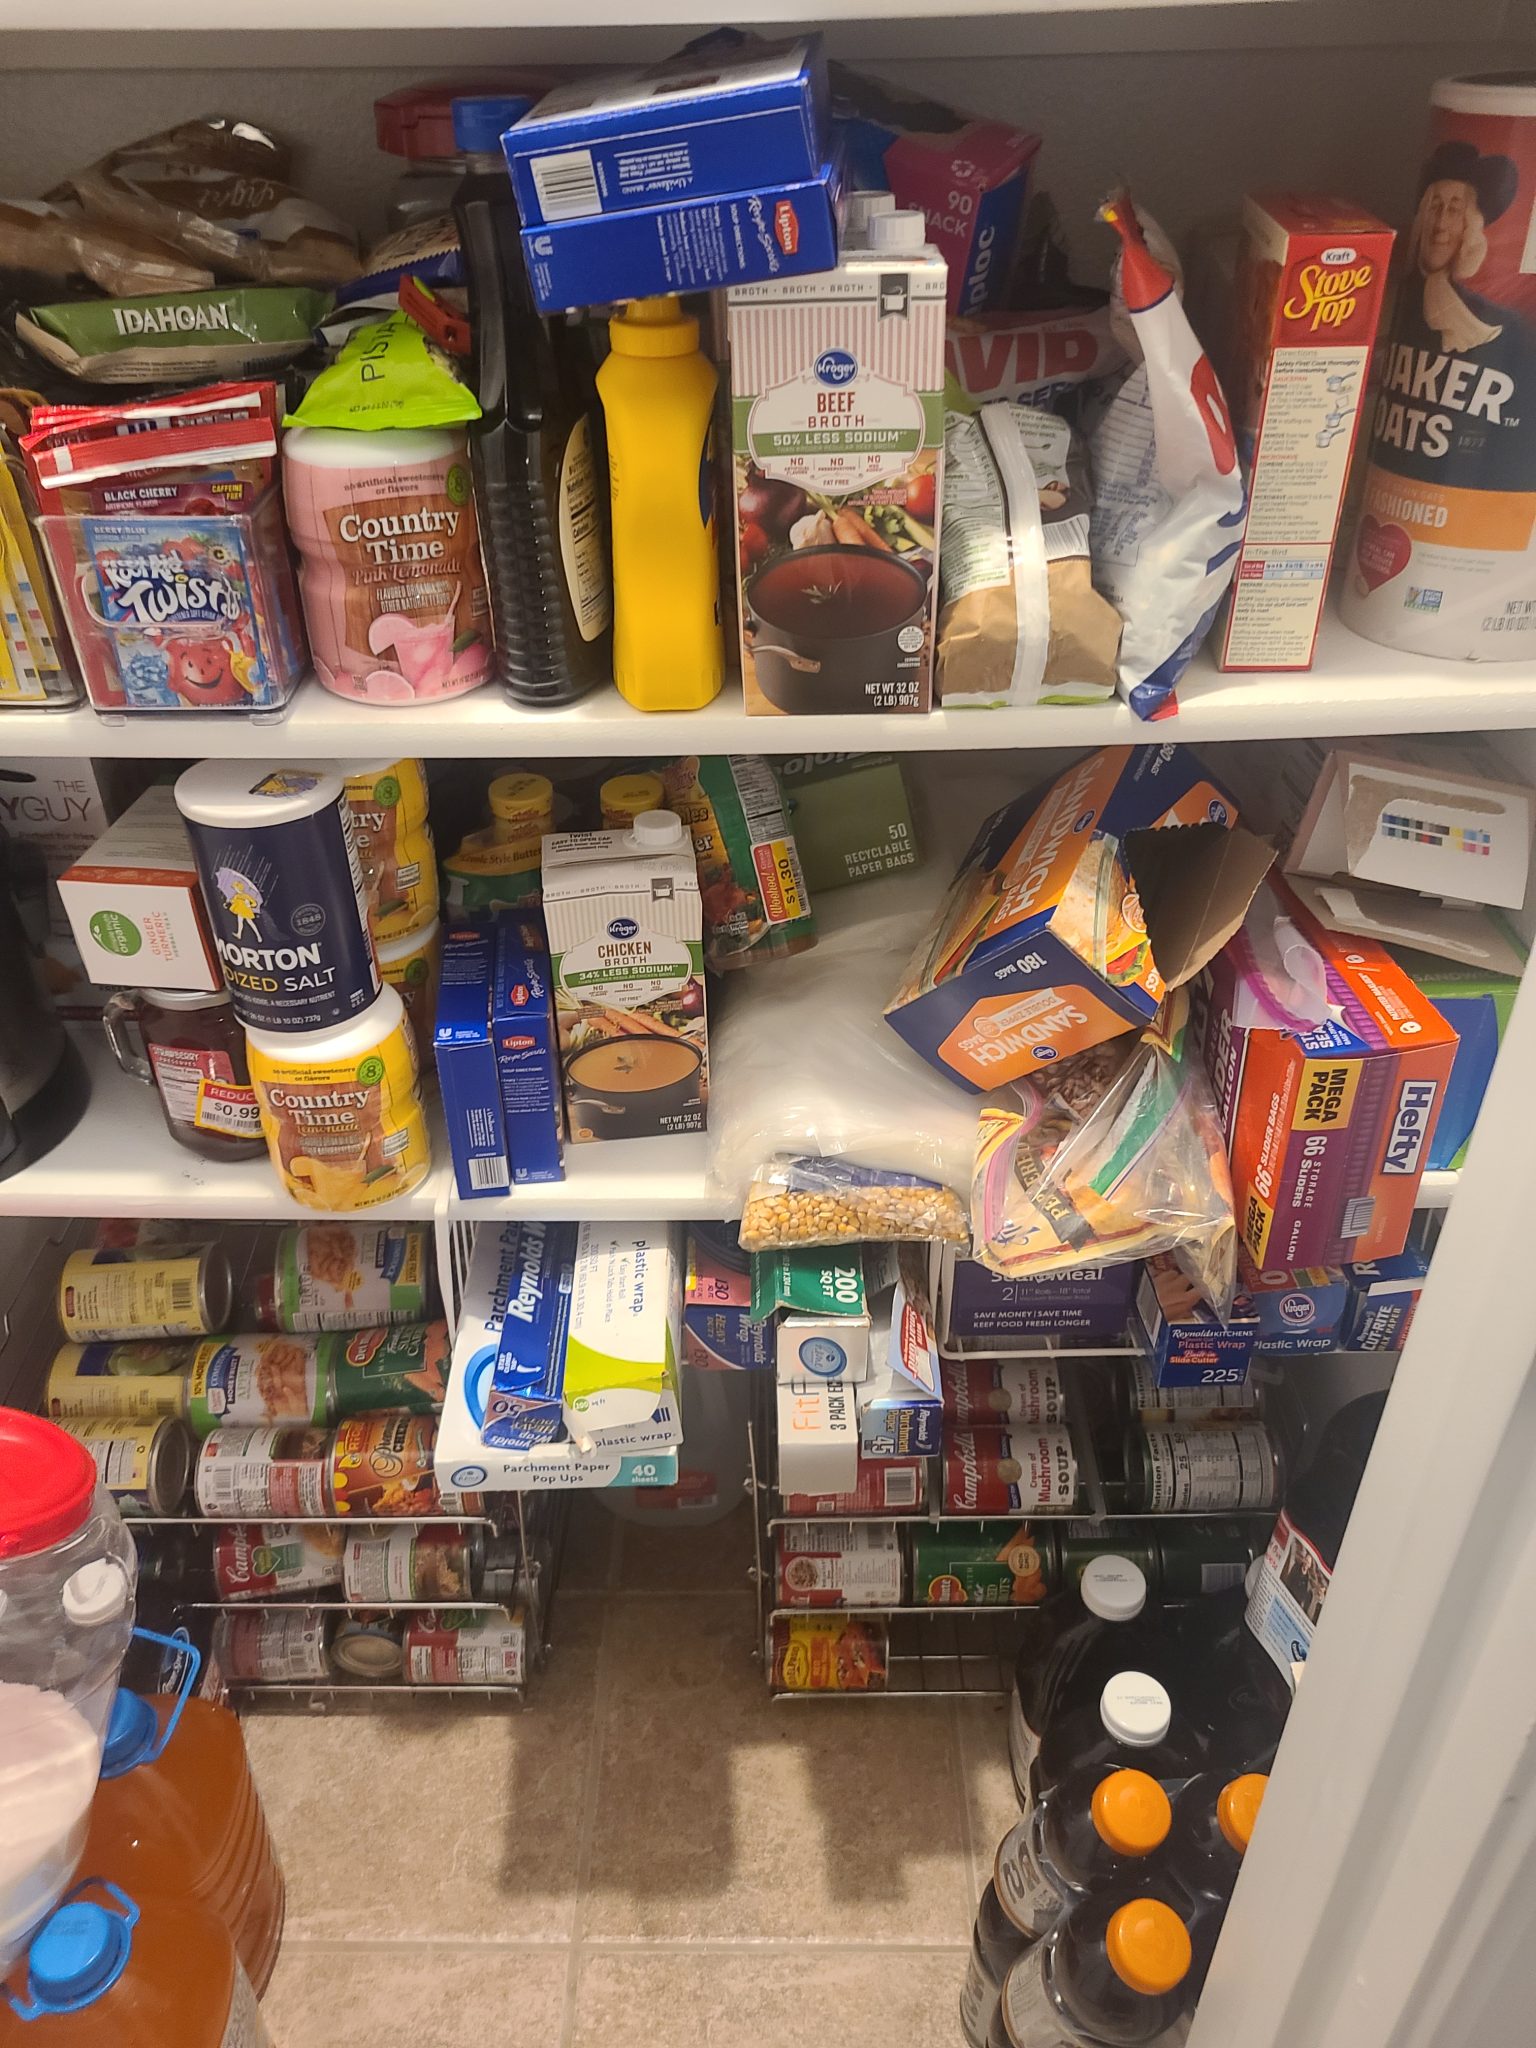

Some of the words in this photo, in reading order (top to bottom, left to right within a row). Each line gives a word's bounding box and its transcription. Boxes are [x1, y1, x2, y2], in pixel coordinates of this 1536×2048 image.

[948, 192, 973, 215] 90
[779, 202, 797, 253] Lipton
[1325, 252, 1351, 262] Kraft
[735, 287, 769, 296] BROTH
[782, 285, 816, 294] BROTH
[830, 284, 864, 293] BROTH
[1283, 264, 1372, 319] Stove
[112, 303, 230, 335] IDAHOAN
[1310, 295, 1356, 332] Top
[361, 317, 402, 384] PISTA
[818, 357, 856, 381] Kroger
[817, 392, 856, 413] BEEF
[808, 415, 865, 428] BROTH
[773, 434, 801, 447] 50%
[805, 432, 840, 445] LESS
[791, 458, 804, 466] NO
[830, 457, 844, 466] NO
[868, 455, 881, 464] NO
[104, 488, 136, 501] BLACK
[139, 486, 178, 500] CHERRY
[387, 483, 419, 494] flavors
[339, 506, 460, 543] Country
[366, 540, 446, 566] Time
[351, 569, 388, 586] Pink
[865, 683, 881, 695] NET
[882, 683, 894, 694] WT
[896, 682, 907, 693] 32
[908, 682, 919, 693] OZ
[873, 695, 883, 707] (2
[884, 695, 898, 707] LB)
[899, 694, 919, 707] 907g
[54, 779, 86, 793] THE
[889, 822, 908, 840] 50
[1007, 757, 1108, 918] SANDWICH
[844, 839, 911, 865] RECYCLABLE
[848, 860, 883, 878] PAPER
[886, 852, 915, 868] BAGS
[296, 913, 321, 927] 1848
[608, 922, 638, 937] Kroger
[117, 913, 130, 954] organic
[142, 917, 160, 957] GINGER
[151, 911, 173, 961] TURMERIC
[598, 941, 652, 959] CHICKEN
[604, 956, 647, 967] BROTH
[994, 962, 1015, 980] BAGS
[1016, 951, 1048, 974] 180
[224, 966, 279, 992] DIZED
[284, 966, 336, 992] SALT
[579, 971, 601, 981] 34%
[603, 967, 629, 978] LESS
[515, 985, 525, 1006] Lipton
[504, 1037, 534, 1047] Lipton
[957, 1035, 984, 1052] BAGS
[968, 1005, 1089, 1066] SANDWICH
[366, 1064, 377, 1078] 8
[210, 1087, 256, 1100] REDUC
[270, 1088, 370, 1110] Country
[1221, 1049, 1238, 1135] GALLON
[1303, 1070, 1329, 1122] PACK
[1322, 1068, 1349, 1124] MEGA
[214, 1101, 261, 1120] $0.99
[288, 1110, 356, 1126] Time
[660, 1116, 672, 1124] NET
[674, 1115, 683, 1123] WT
[684, 1114, 692, 1122] 32
[1260, 1126, 1275, 1167] SLIDER
[1268, 1093, 1280, 1126] BAGS
[1387, 1084, 1433, 1172] Hefty
[1304, 1135, 1328, 1156] 66
[1253, 1169, 1273, 1199] 66
[1291, 1158, 1313, 1208] SLIDERS
[1303, 1160, 1322, 1209] STORAGE
[1286, 1219, 1302, 1262] GALLON
[631, 1240, 647, 1283] plastic
[506, 1236, 546, 1323] Reynolds
[821, 1270, 834, 1284] SQ
[834, 1266, 859, 1303] 200
[714, 1278, 730, 1301] 130
[821, 1284, 834, 1298] FT
[628, 1285, 647, 1314] wrap
[1284, 1300, 1312, 1318] Kroger
[973, 1321, 996, 1329] KEEP
[997, 1320, 1024, 1329] FOOD
[1025, 1320, 1052, 1328] FRESH
[1054, 1318, 1091, 1327] LONGER
[974, 1310, 996, 1319] SAVE
[998, 1310, 1033, 1318] MONEY
[1037, 1309, 1060, 1318] SAVE
[1061, 1309, 1083, 1317] TIME
[736, 1313, 751, 1343] Wrap
[1172, 1328, 1214, 1340] Reynolds
[1213, 1330, 1254, 1338] KITCHENS
[753, 1319, 768, 1365] Reynolds
[1178, 1340, 1214, 1350] Plastic
[1216, 1340, 1246, 1351] Wrap
[1295, 1338, 1331, 1351] Wrap
[1191, 1356, 1219, 1364] Cutter
[1200, 1369, 1239, 1383] 225
[492, 1399, 521, 1418] 50
[829, 1394, 846, 1417] PACK
[830, 1417, 847, 1431] 3
[883, 1408, 899, 1433] Paper
[916, 1408, 931, 1442] Reynolds
[595, 1436, 637, 1448] plastic
[639, 1431, 672, 1445] wrap
[898, 1408, 915, 1454] Parchment
[490, 1434, 532, 1448] ynolds
[871, 1435, 894, 1455] 45
[503, 1463, 571, 1473] Parchment
[573, 1462, 610, 1473] Paper
[1029, 1452, 1036, 1464] of
[1179, 1455, 1188, 1470] 25
[532, 1473, 556, 1483] Pop
[559, 1473, 584, 1483] Ups
[631, 1475, 659, 1484] sheets
[632, 1464, 656, 1476] 40
[1029, 1465, 1038, 1489] Cream
[1038, 1437, 1052, 1503] Mushroom
[1056, 1445, 1070, 1495] SOUP
